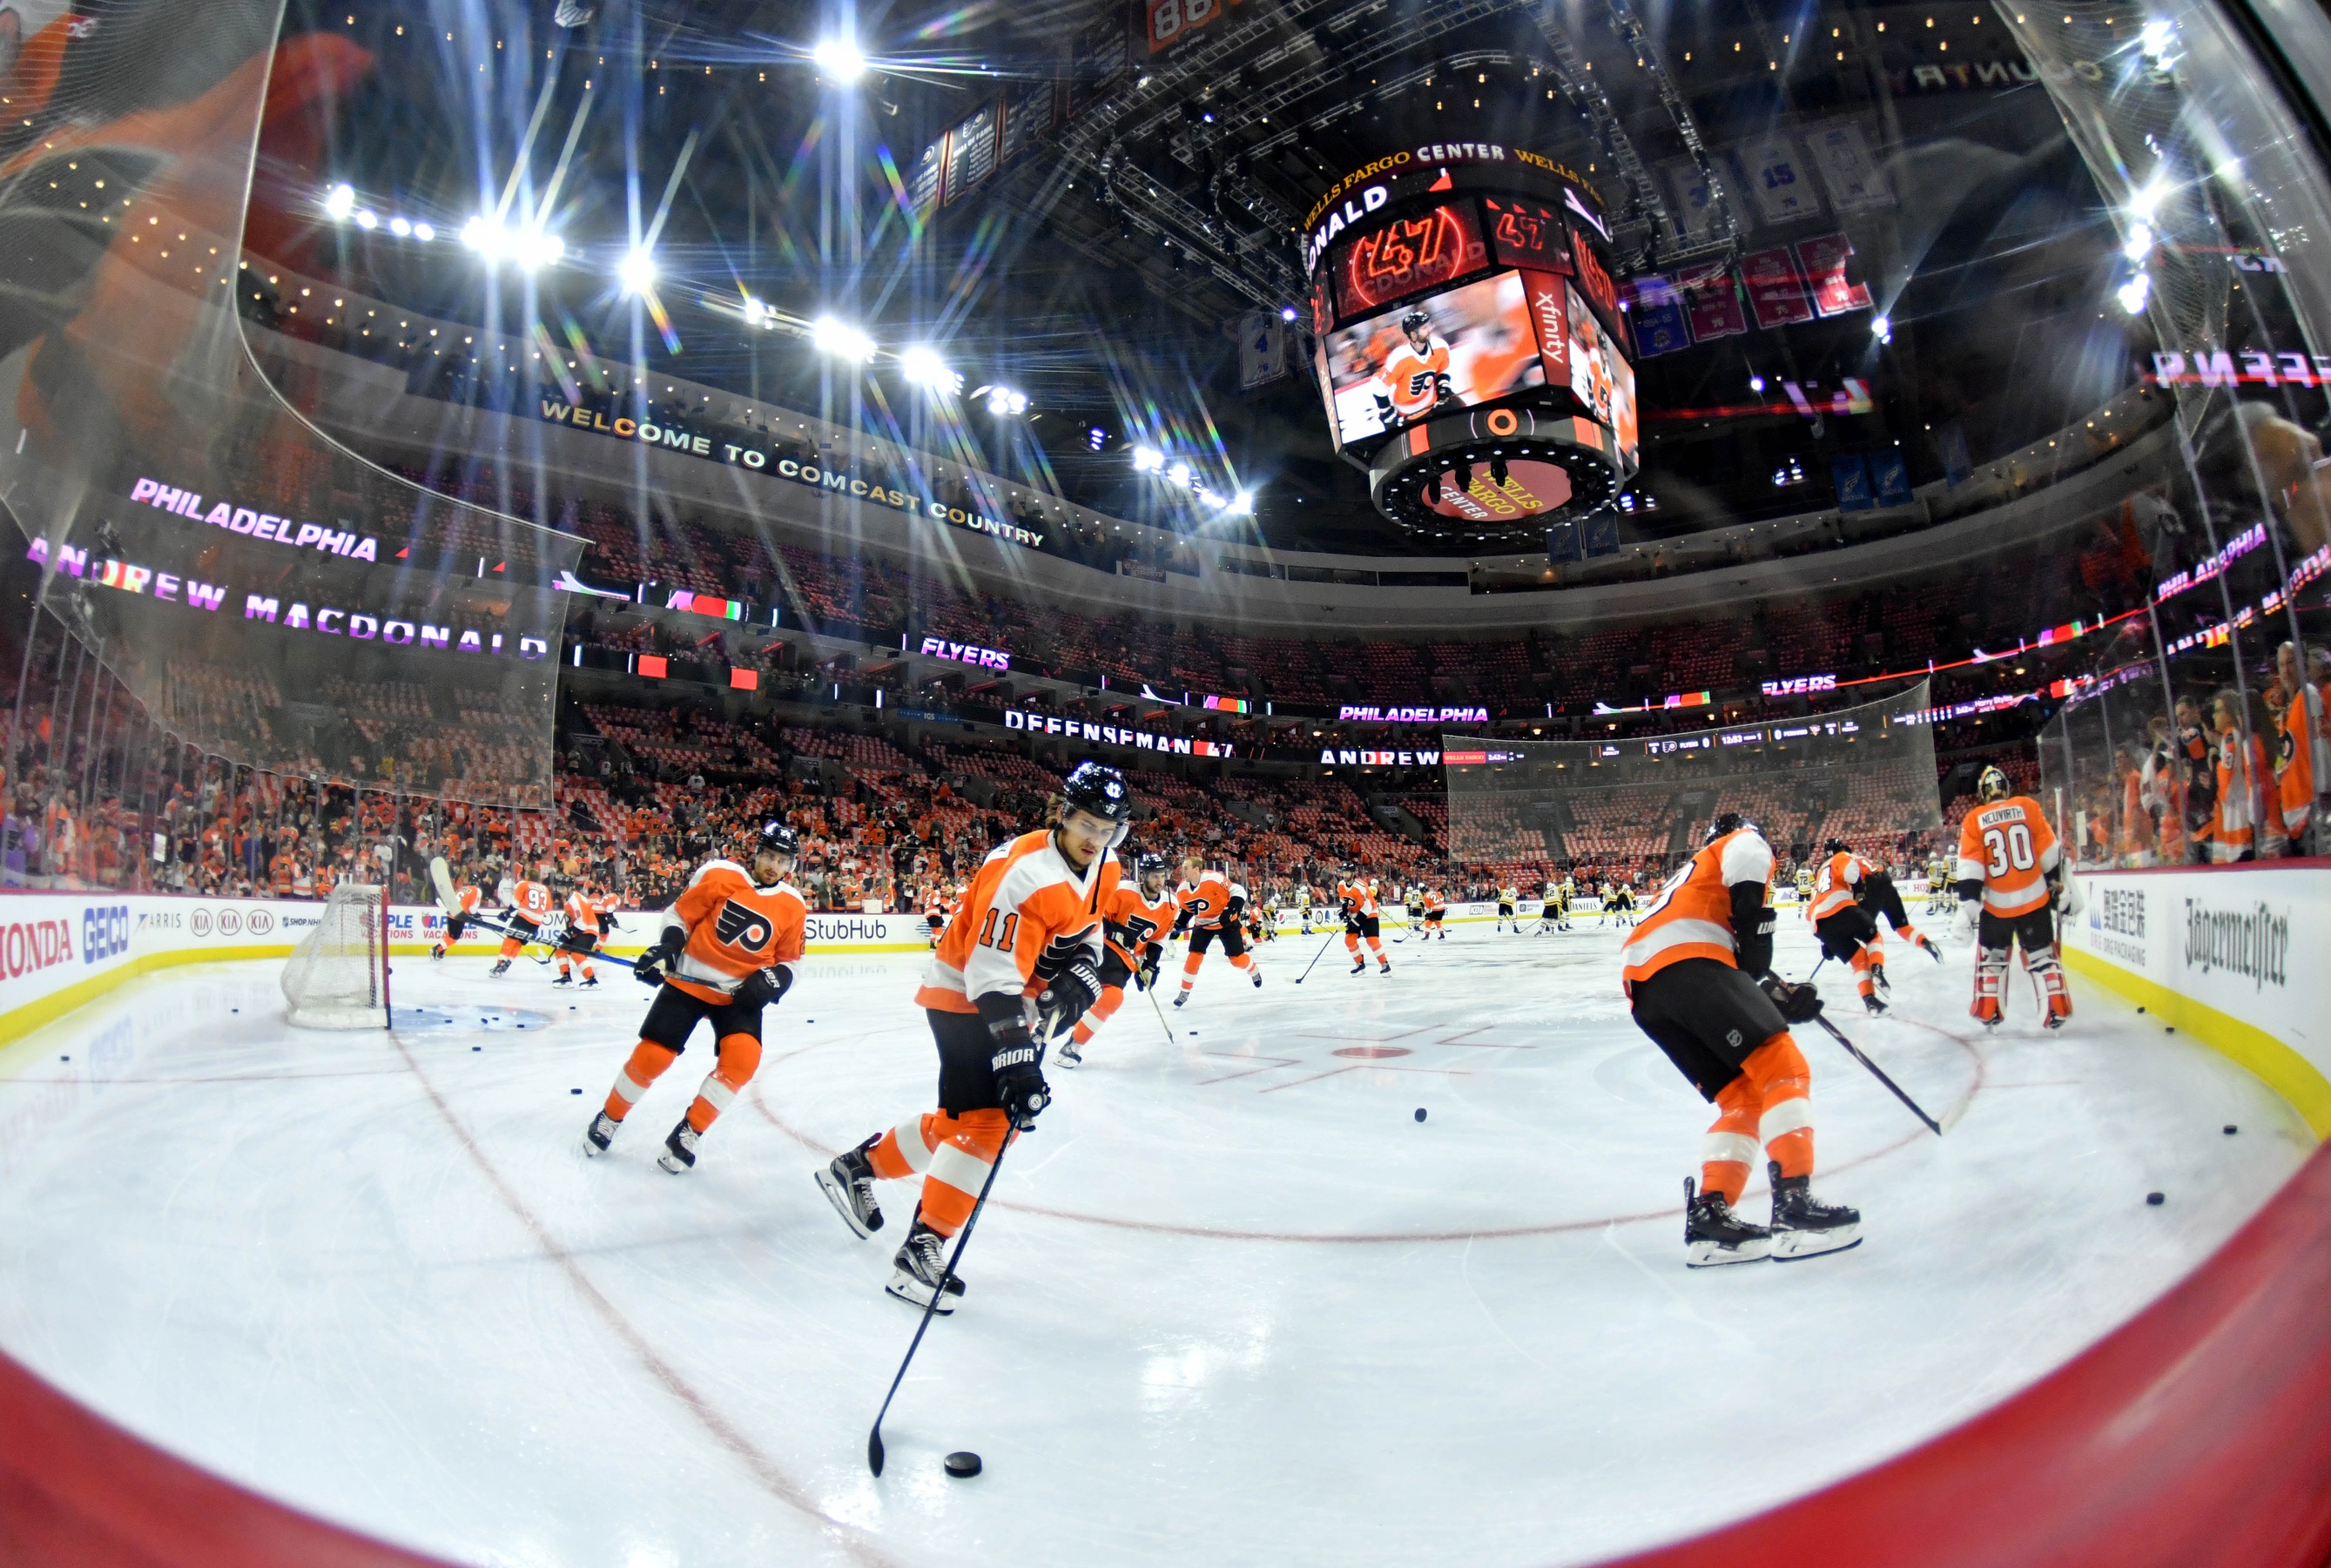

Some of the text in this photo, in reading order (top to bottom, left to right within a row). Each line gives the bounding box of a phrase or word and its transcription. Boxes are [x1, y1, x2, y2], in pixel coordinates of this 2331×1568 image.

[1512, 148, 1580, 184] WELLS
[1304, 143, 1505, 231] WELLS FARGO CENTER
[1535, 291, 1564, 364] xfinity
[541, 400, 1045, 548] WELCOME TO COMCAST COUNTRY
[1439, 486, 1489, 519] CENTER
[131, 477, 378, 562] PHILADELPHIA
[920, 636, 1011, 670] FLYERS
[1762, 674, 1836, 697] FLYERS
[1339, 705, 1489, 723] PHILADELPHIA
[1320, 750, 1440, 766] ANDREW
[1982, 808, 2024, 824] NEUVIRTH
[1984, 823, 2035, 878] 30
[1799, 876, 1809, 886] 72
[528, 889, 548, 912] 93
[149, 912, 181, 929] ARRIS
[193, 914, 270, 931] KIA KIA KIA
[805, 919, 887, 940] StubHub
[980, 906, 1020, 953] 11
[83, 905, 129, 965] GEICO
[502, 929, 563, 948] BAUER
